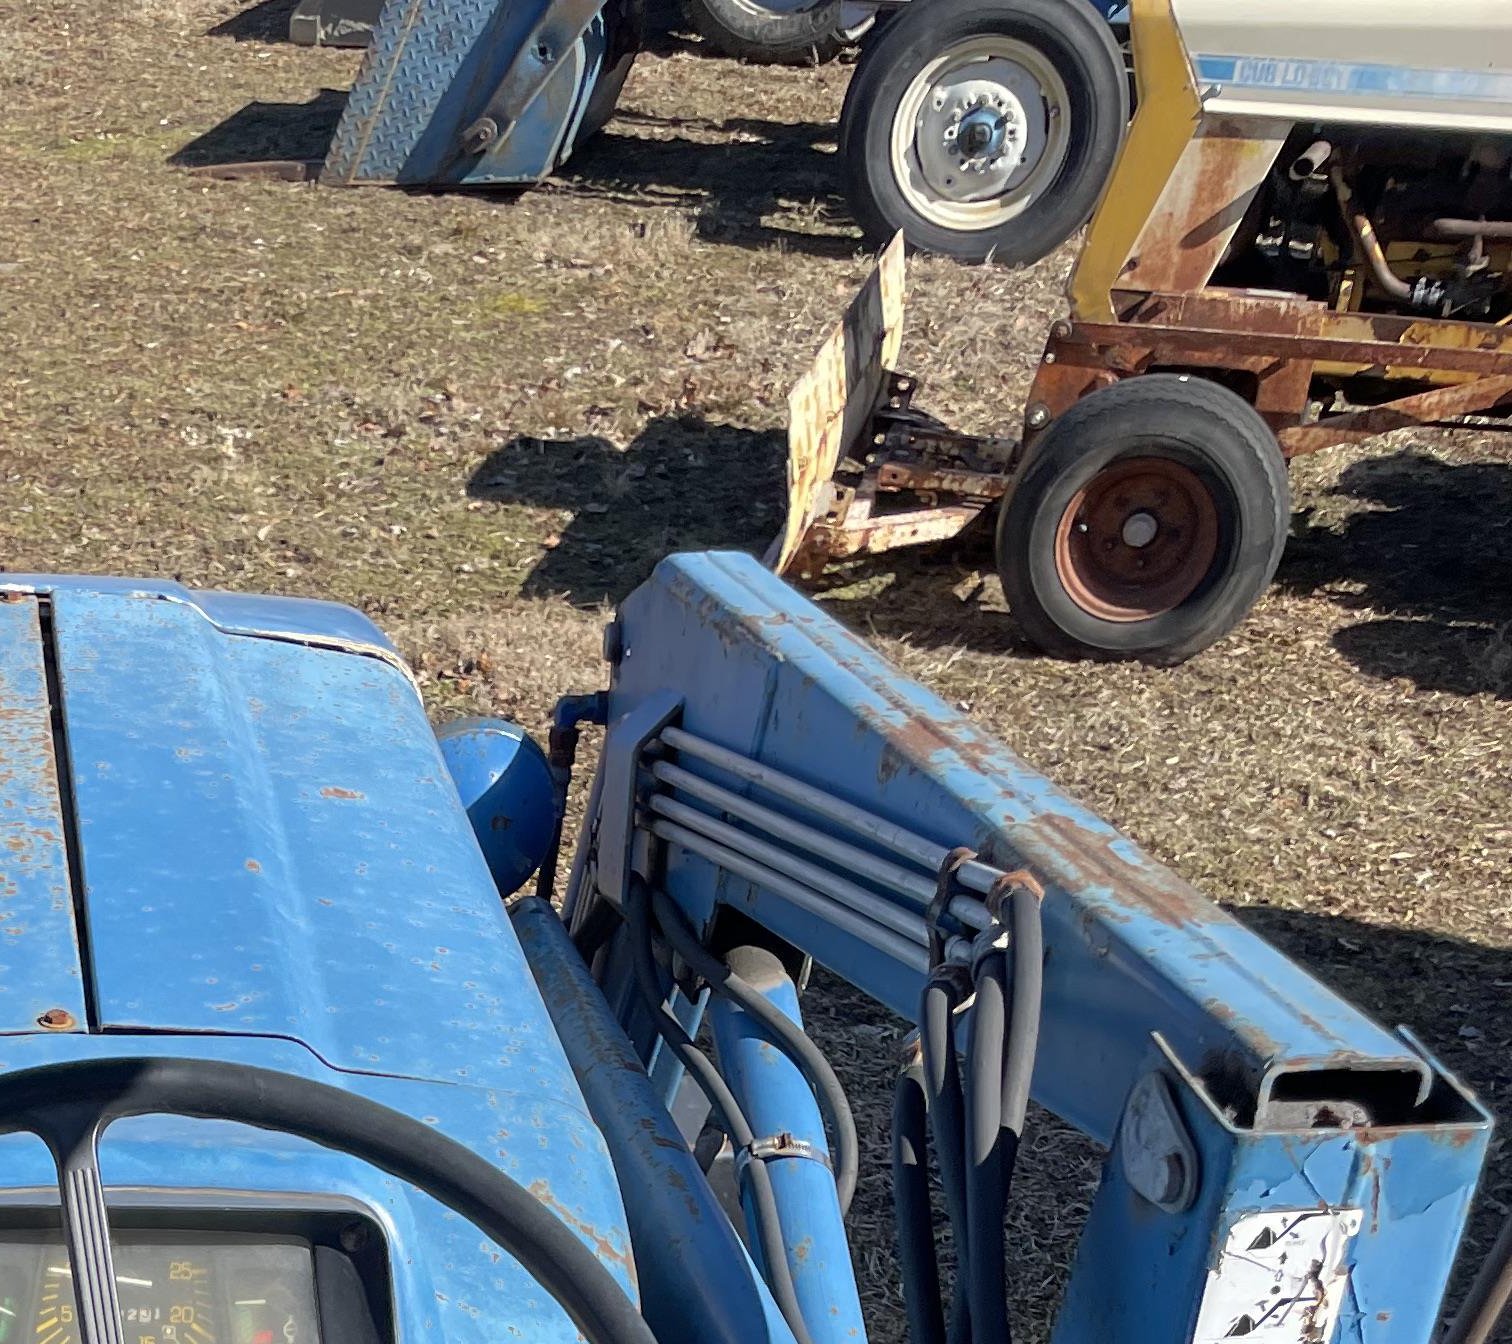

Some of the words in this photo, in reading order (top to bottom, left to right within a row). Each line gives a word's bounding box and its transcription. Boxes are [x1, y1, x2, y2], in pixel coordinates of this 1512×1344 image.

[1239, 60, 1278, 84] CUB
[170, 1261, 193, 1280] 25
[61, 1305, 72, 1322] 5
[170, 1306, 194, 1324] 20
